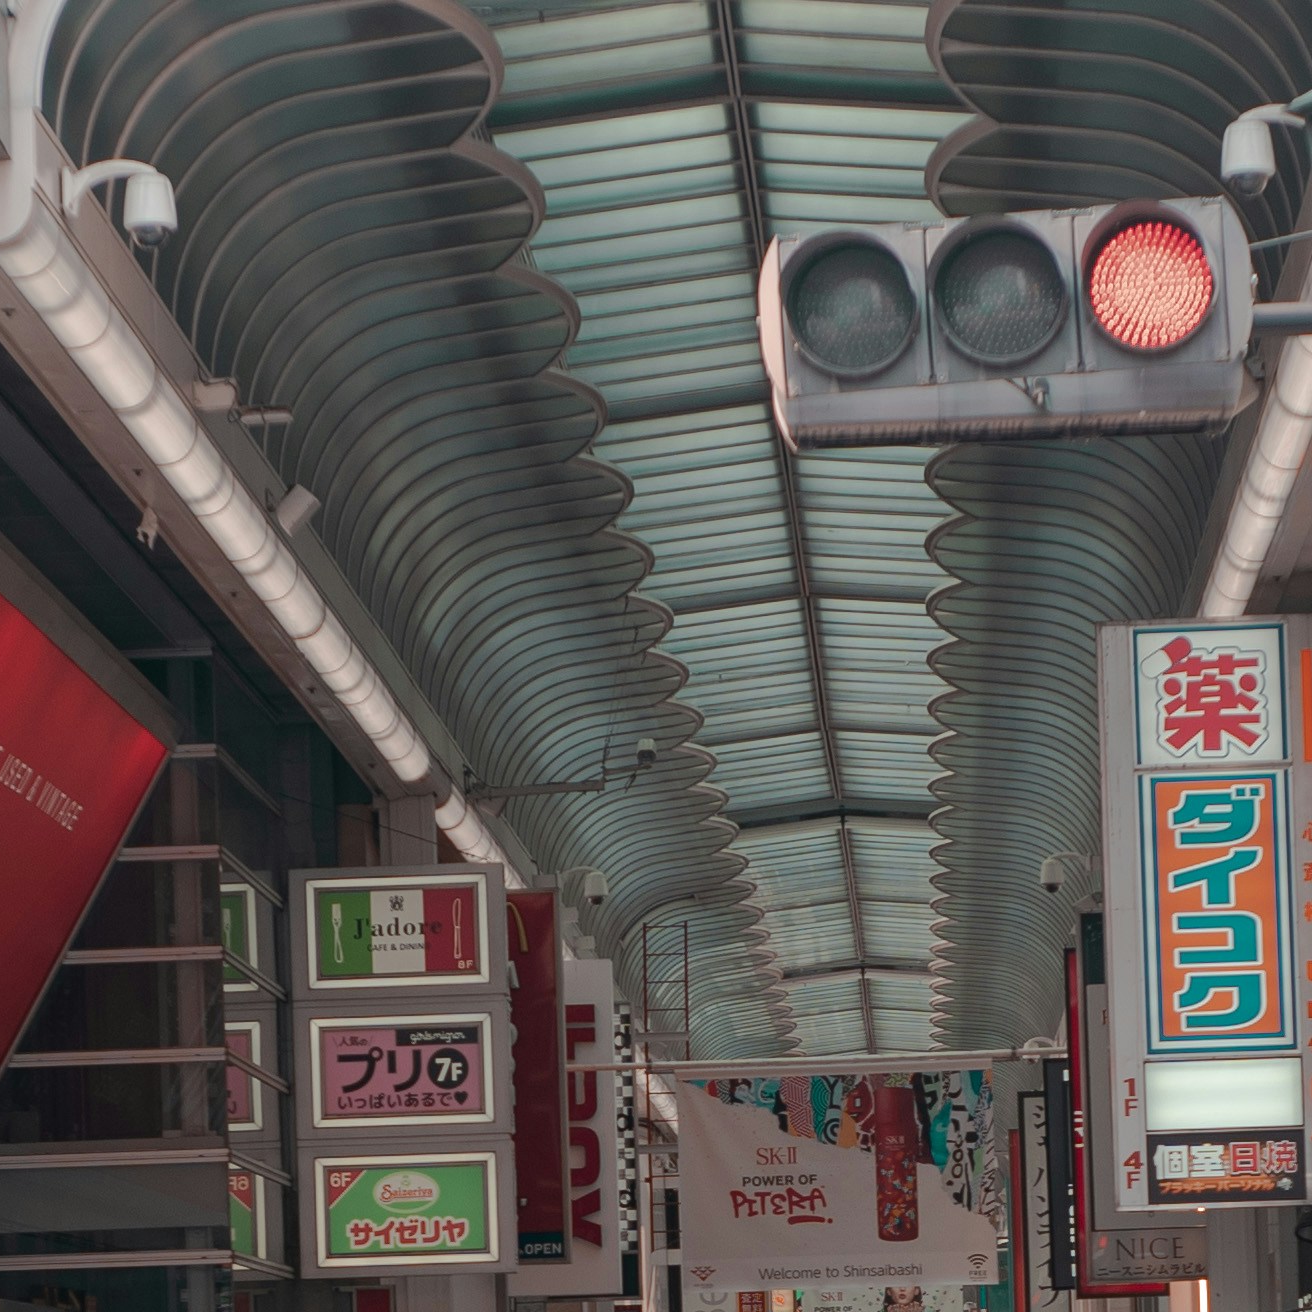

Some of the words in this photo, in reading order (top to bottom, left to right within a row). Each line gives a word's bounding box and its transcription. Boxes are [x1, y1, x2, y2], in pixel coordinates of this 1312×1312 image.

[1164, 650, 1262, 752] 薬
[36, 780, 84, 831] VINTAGE
[1167, 784, 1265, 1030] ダイコク
[352, 917, 443, 940] J'adore
[390, 943, 398, 951] &
[457, 959, 474, 969] 8F
[336, 1046, 422, 1094] プリ
[434, 1056, 464, 1082] 7F
[337, 1091, 454, 1111] いっぱいあるで
[1123, 1076, 1138, 1118] 1F
[1123, 1150, 1144, 1190] 4F
[1153, 1140, 1299, 1180] 個室日焼
[329, 1172, 352, 1188] 6F
[742, 1174, 794, 1188] POWER
[797, 1173, 818, 1186] OF
[379, 1184, 434, 1203] Saizeriya
[729, 1185, 828, 1219] PITERA
[348, 1218, 468, 1248] サイゼリヤ
[524, 1243, 562, 1255] OPEN
[1114, 1236, 1186, 1261] NICE
[758, 1266, 821, 1281] Welcome
[826, 1266, 839, 1279] to
[843, 1263, 924, 1279] Shinsaibashi
[1096, 1263, 1207, 1278] ニースニシムラビル
[814, 1305, 840, 1312] POWER
